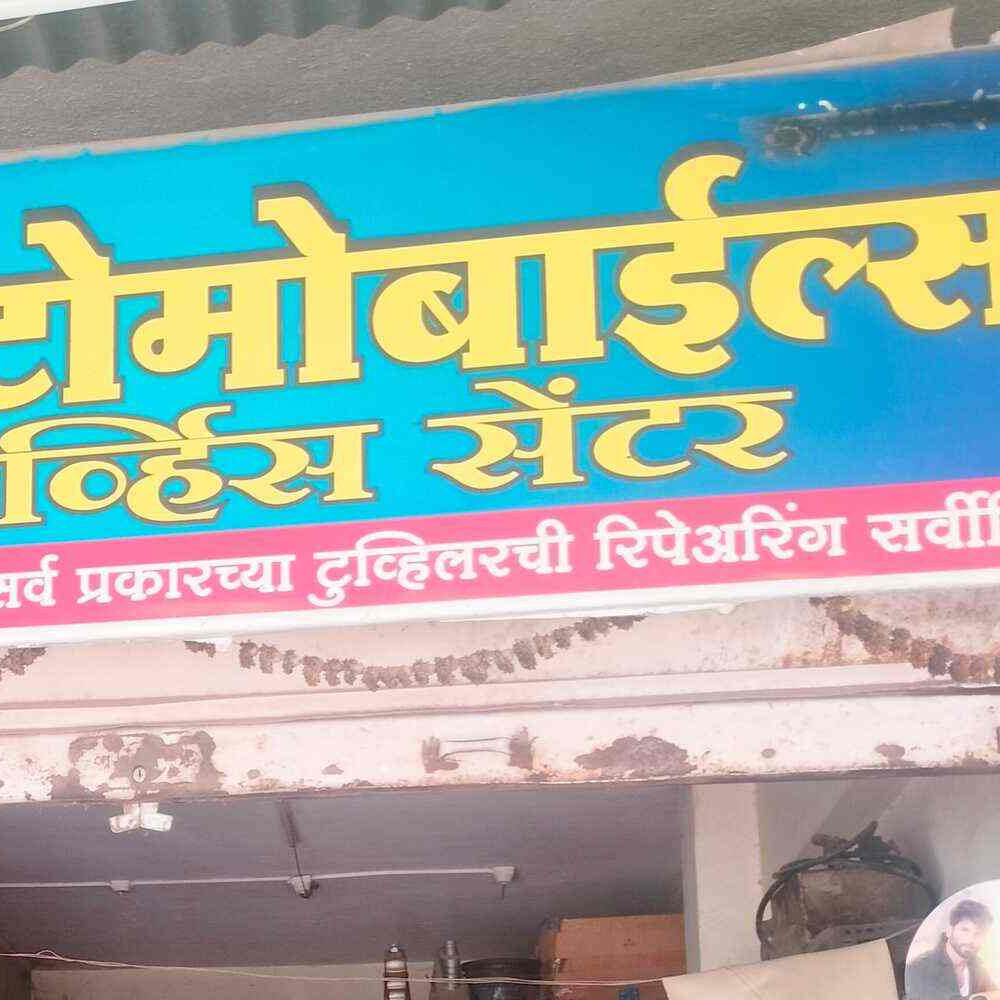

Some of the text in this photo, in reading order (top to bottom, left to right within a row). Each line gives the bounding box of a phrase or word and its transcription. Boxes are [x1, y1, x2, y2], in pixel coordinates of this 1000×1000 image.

[426, 376, 793, 491] सेंटर
[75, 554, 297, 604] प्रकारच्या
[307, 518, 575, 608] टुव्हिलरची
[592, 501, 848, 571] रिपेअरिंग
